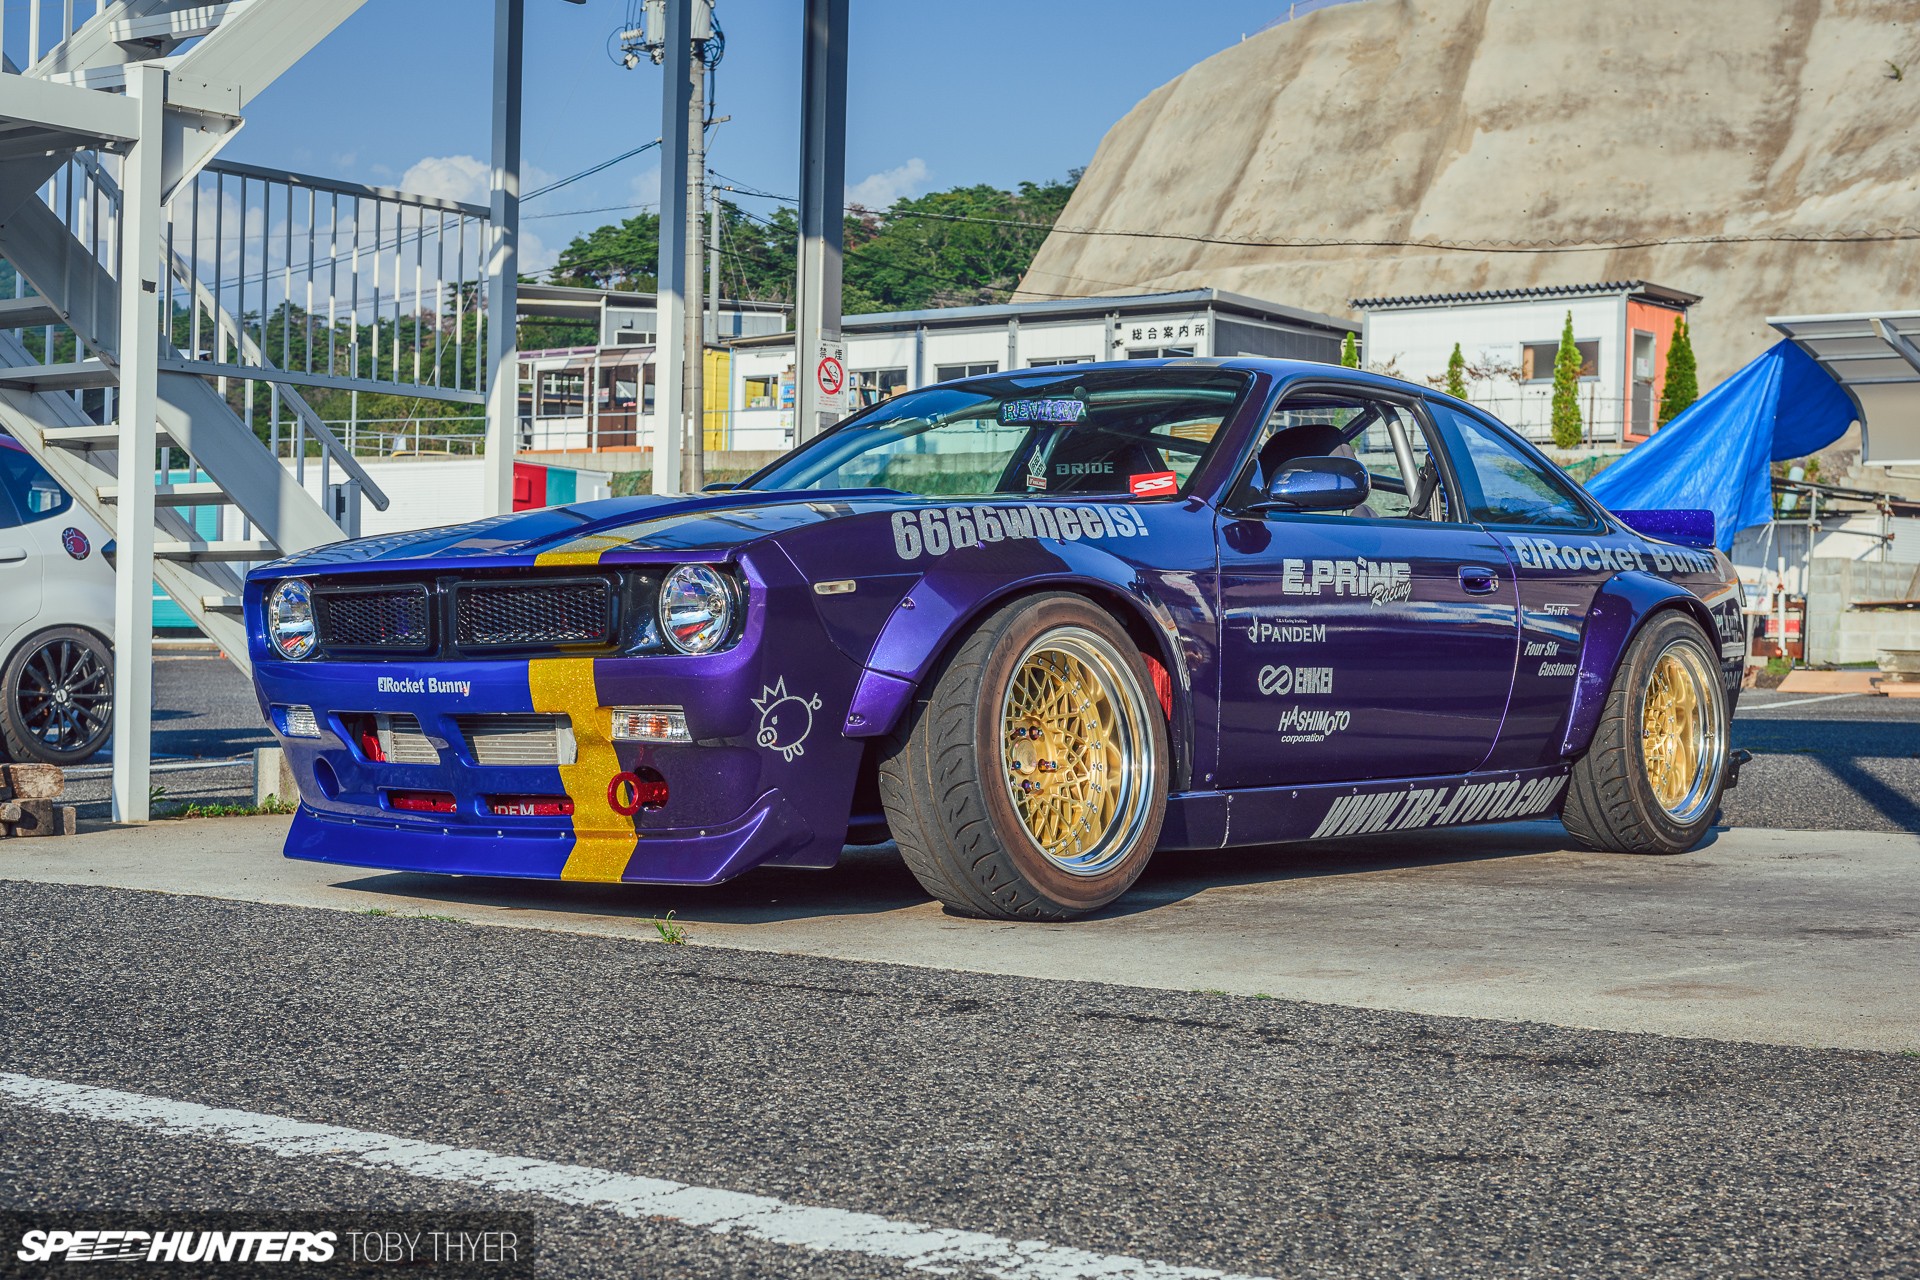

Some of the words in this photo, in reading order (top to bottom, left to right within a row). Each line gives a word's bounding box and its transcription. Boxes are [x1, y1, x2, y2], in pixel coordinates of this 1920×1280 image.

[1132, 324, 1205, 340] 総合案内所
[1003, 400, 1083, 422] REVIEW
[1055, 461, 1114, 475] BRIDE
[891, 504, 1149, 560] 6666wheels!
[1531, 538, 1648, 571] Rocket
[1643, 542, 1726, 583] Bunny
[1370, 581, 1413, 609] Racing
[1540, 603, 1580, 616] Shift
[1524, 641, 1546, 656] Four
[1544, 641, 1560, 656] Six
[1538, 661, 1577, 677] Customs
[386, 677, 426, 693] Rocket
[428, 677, 471, 697] Bunny
[1294, 667, 1334, 694] ENKEI
[1278, 705, 1351, 736] HASHIMOTO
[1281, 733, 1325, 745] corporation
[1309, 775, 1570, 839] WWW.TRA-KYOTO.COM
